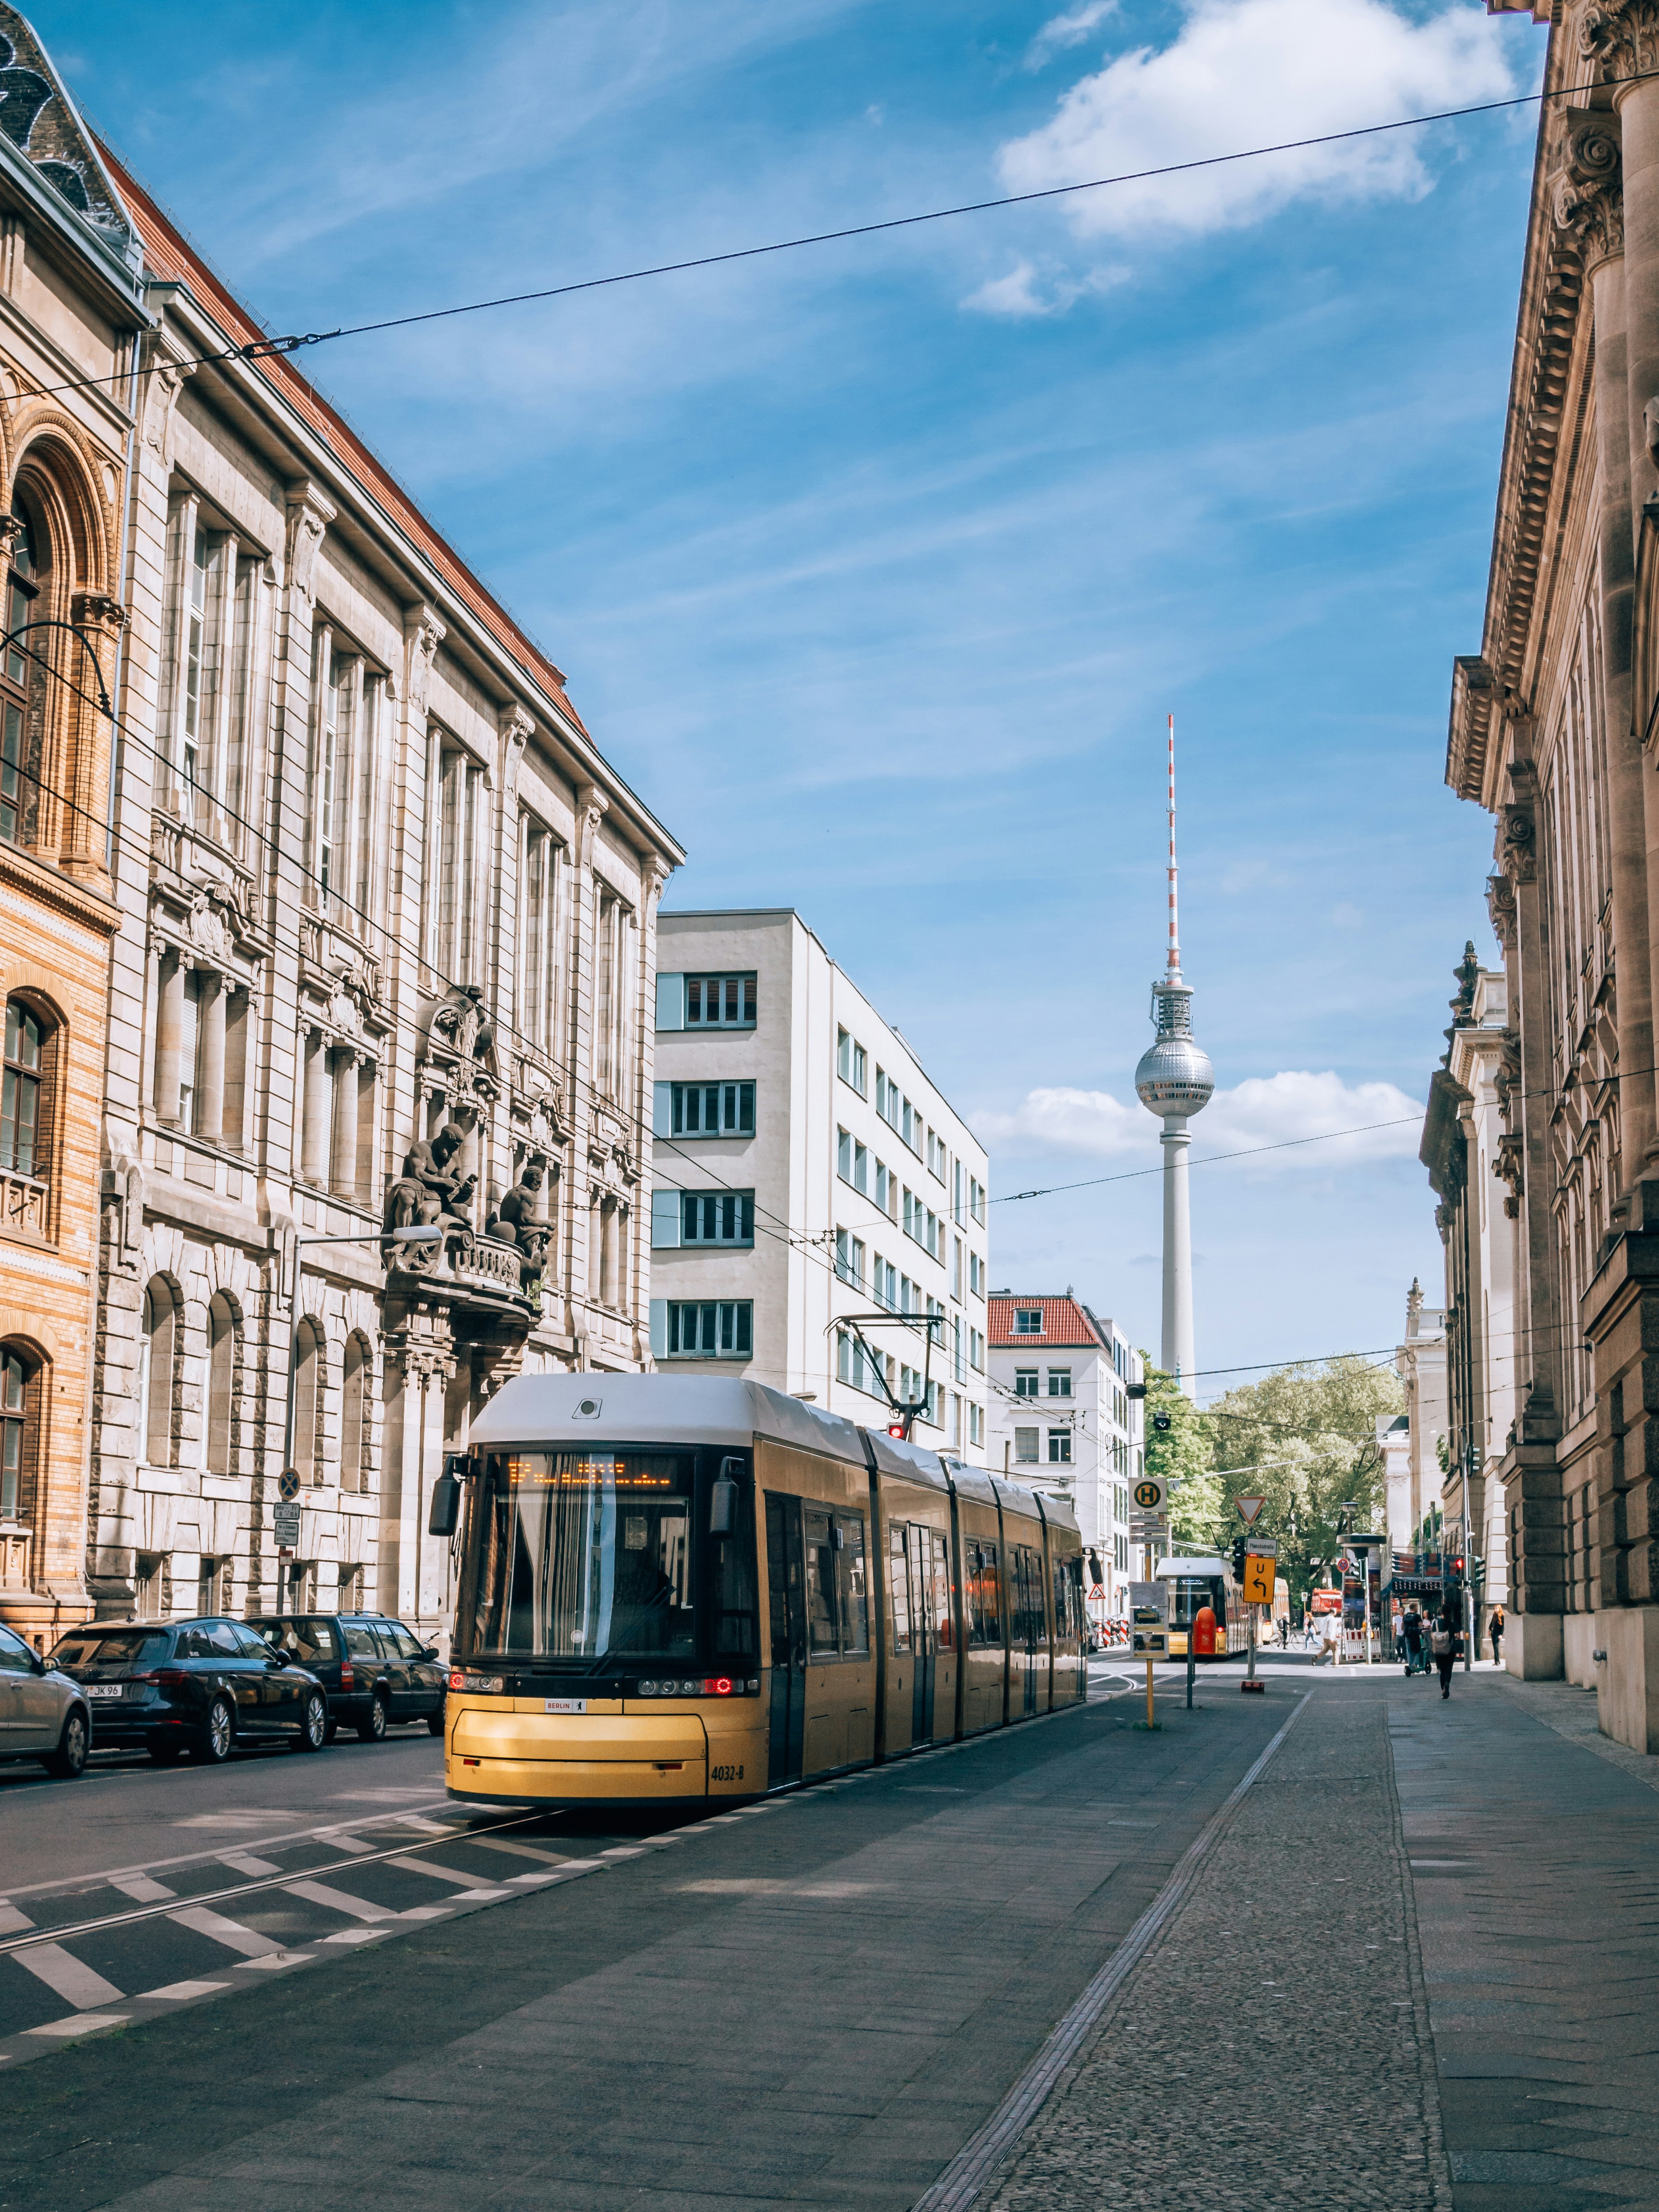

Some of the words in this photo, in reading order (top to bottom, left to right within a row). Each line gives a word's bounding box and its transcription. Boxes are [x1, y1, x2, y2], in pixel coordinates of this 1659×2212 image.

[1141, 1488, 1154, 1502] H
[1257, 1563, 1264, 1574] U
[94, 1686, 106, 1695] JK
[108, 1686, 118, 1695] 96
